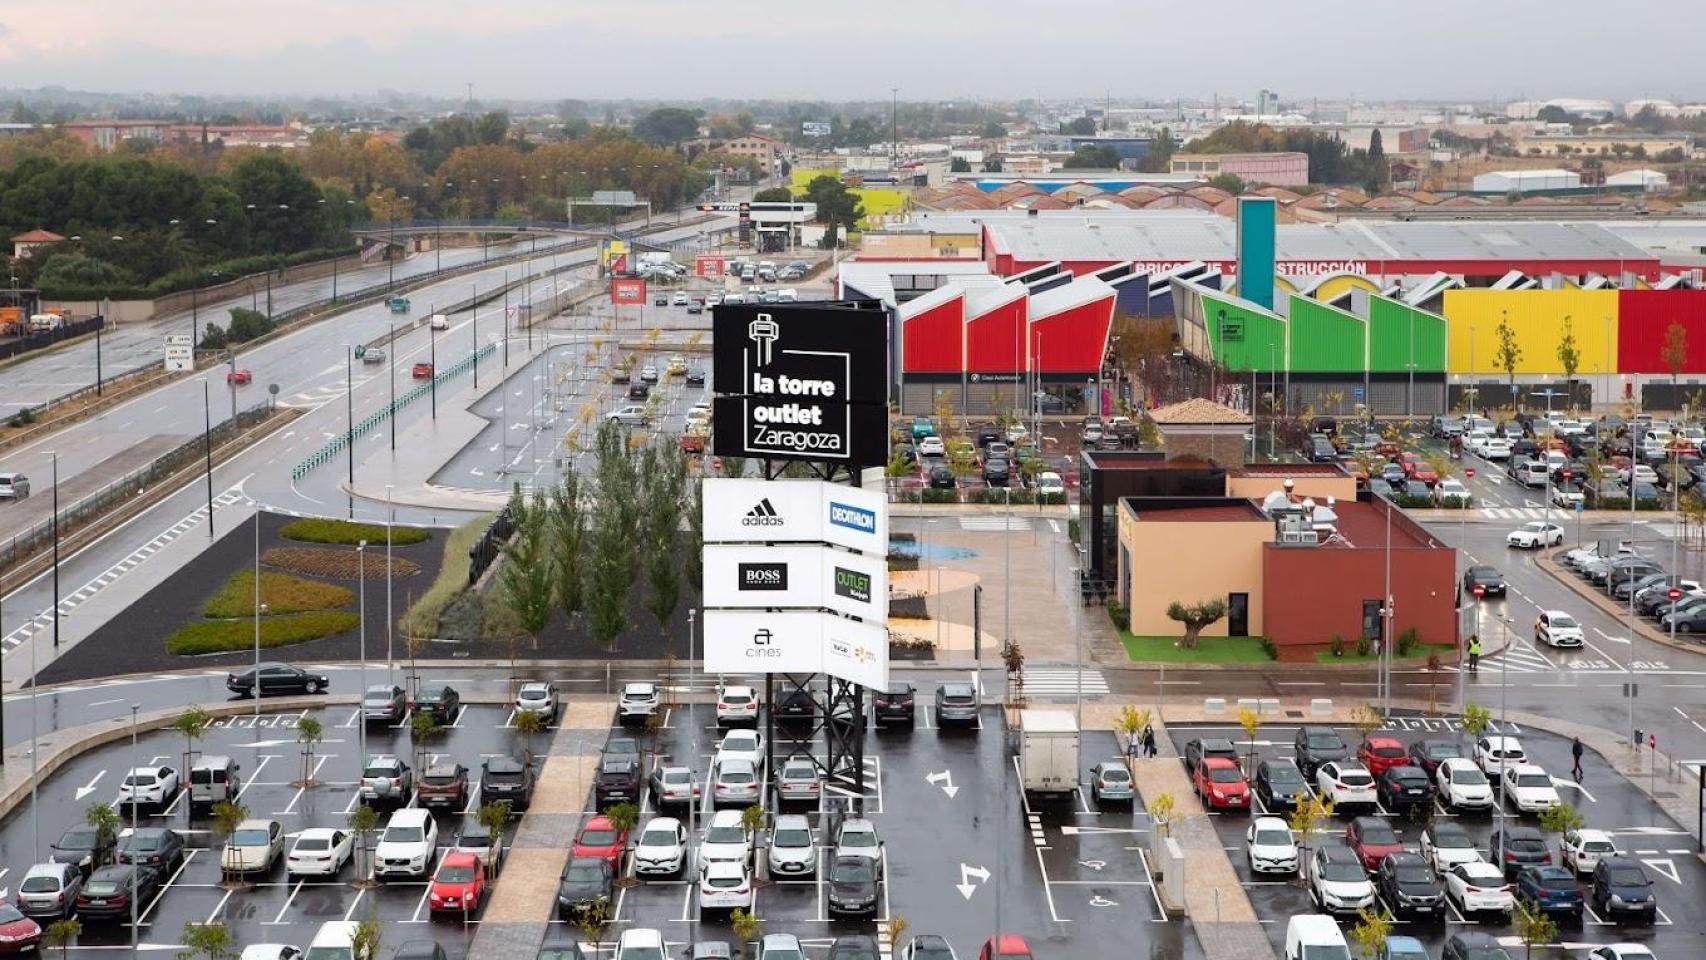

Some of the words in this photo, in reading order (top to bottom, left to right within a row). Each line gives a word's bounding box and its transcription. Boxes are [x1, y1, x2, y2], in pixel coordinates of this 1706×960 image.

[1276, 259, 1366, 275] STRUCCIÓN
[753, 373, 774, 393] la
[778, 374, 835, 396] torre
[753, 403, 822, 425] outlet
[753, 424, 840, 450] Zaragoza
[742, 515, 784, 526] adidas
[746, 570, 781, 580] BOSS
[837, 572, 869, 591] OUTLET
[746, 648, 781, 657] cines
